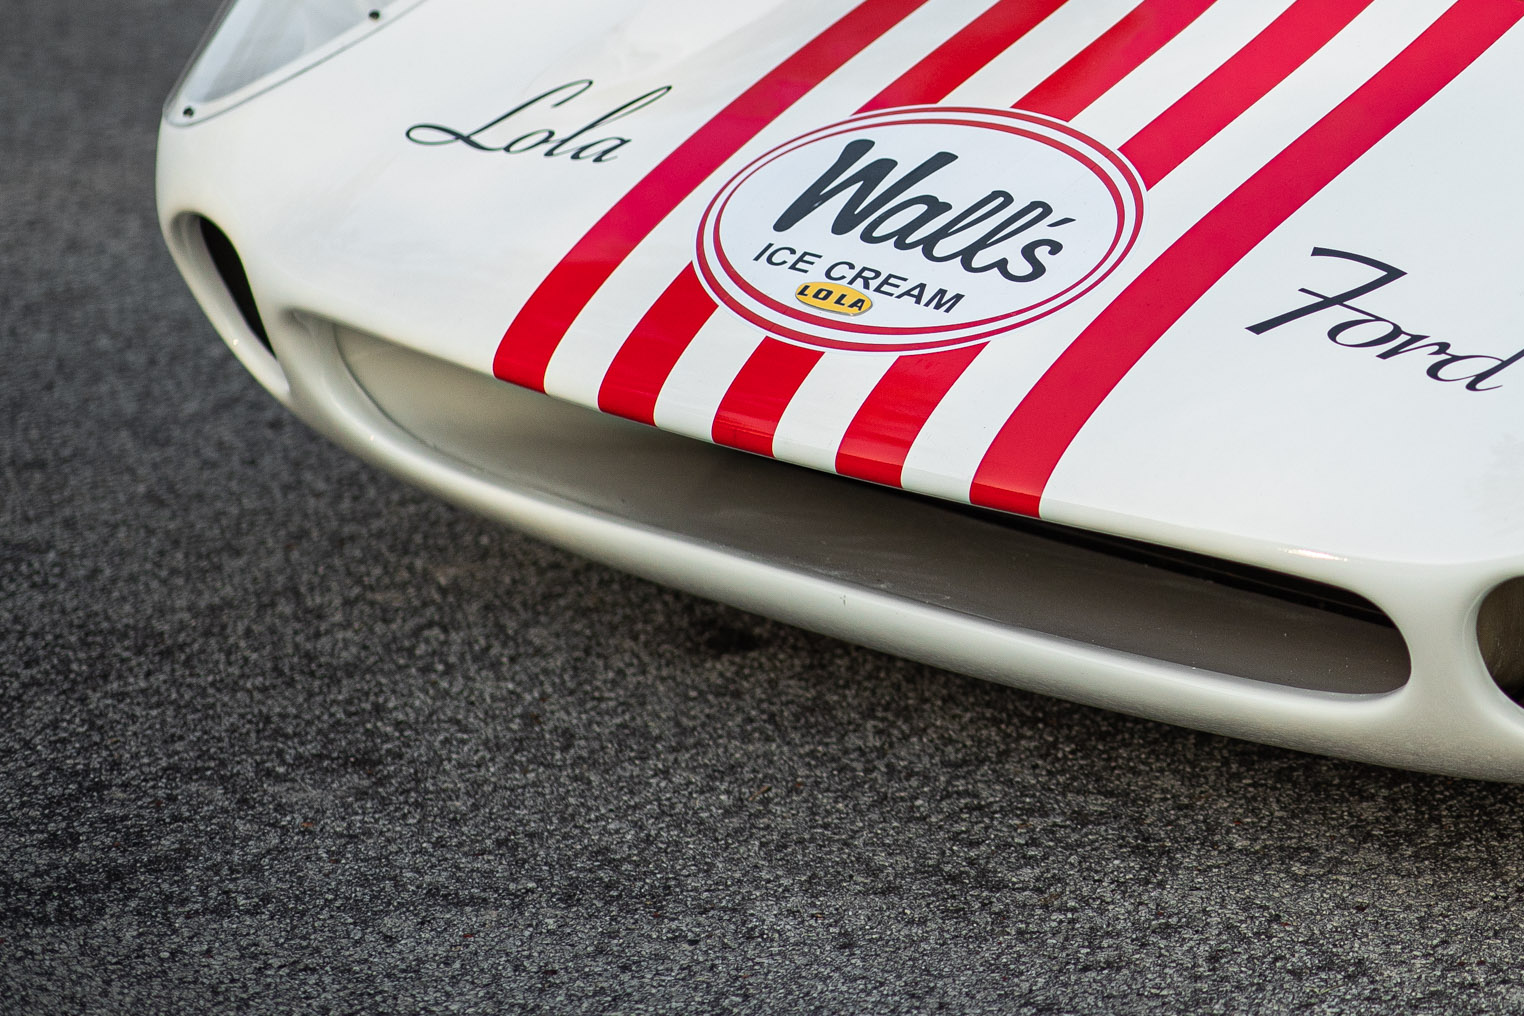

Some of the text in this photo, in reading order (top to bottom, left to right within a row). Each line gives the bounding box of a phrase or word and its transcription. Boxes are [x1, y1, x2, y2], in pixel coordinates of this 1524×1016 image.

[405, 79, 672, 163] Lola
[772, 139, 1076, 283] Wall's
[753, 243, 965, 313] ICE CREAM
[797, 285, 866, 311] LOLA
